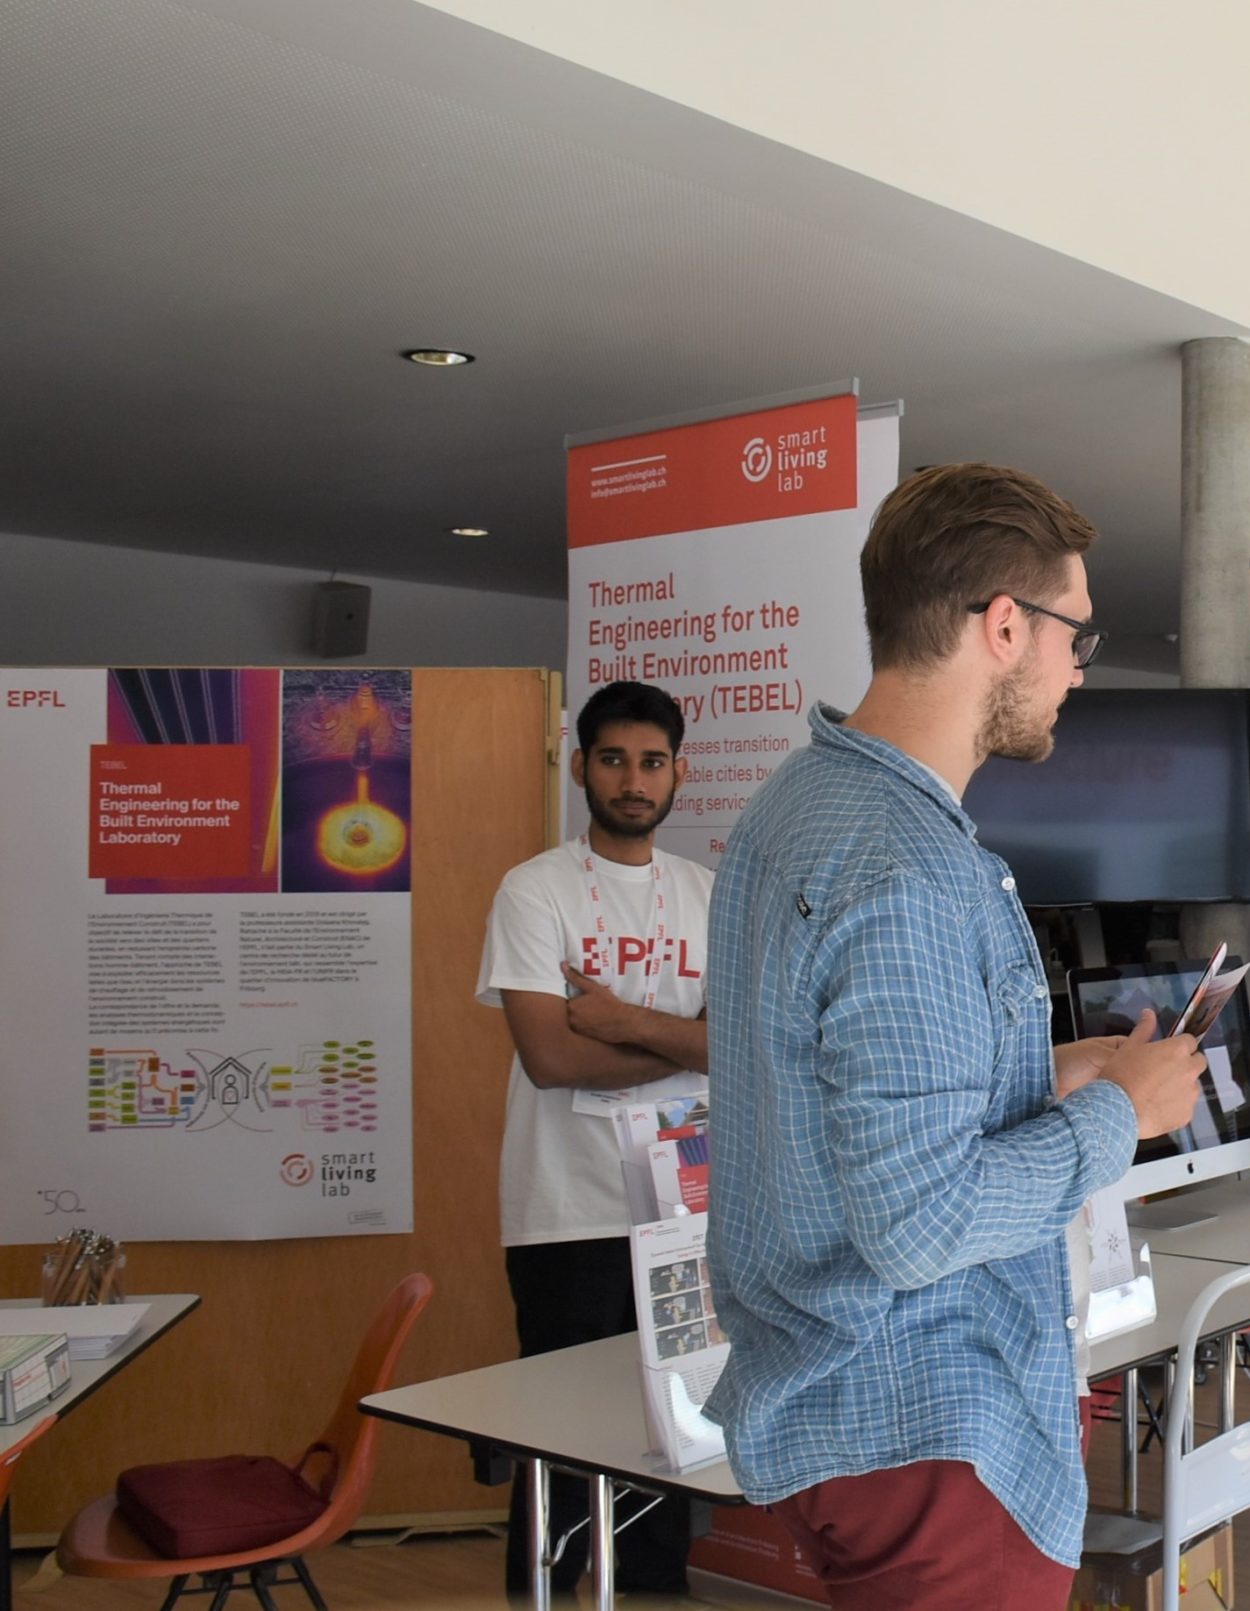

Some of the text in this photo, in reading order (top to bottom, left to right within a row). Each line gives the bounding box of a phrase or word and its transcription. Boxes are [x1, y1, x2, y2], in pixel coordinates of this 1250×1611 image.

[778, 426, 826, 450] smart
[778, 449, 828, 471] living
[778, 473, 803, 492] lab
[588, 573, 674, 608] Thermal
[588, 601, 799, 650] Engineering for the
[588, 643, 788, 683] Built Environment
[7, 690, 66, 708] EPFL
[711, 680, 802, 719] (TEBEL)
[724, 734, 789, 753] transition
[717, 765, 752, 782] cities
[100, 782, 162, 795] Thermal
[100, 797, 239, 814] Engineering for the
[100, 814, 230, 828] Built Environment
[100, 831, 182, 846] Laboratory
[321, 1152, 375, 1165] smart
[321, 1166, 377, 1182] living
[322, 1182, 350, 1197] lab
